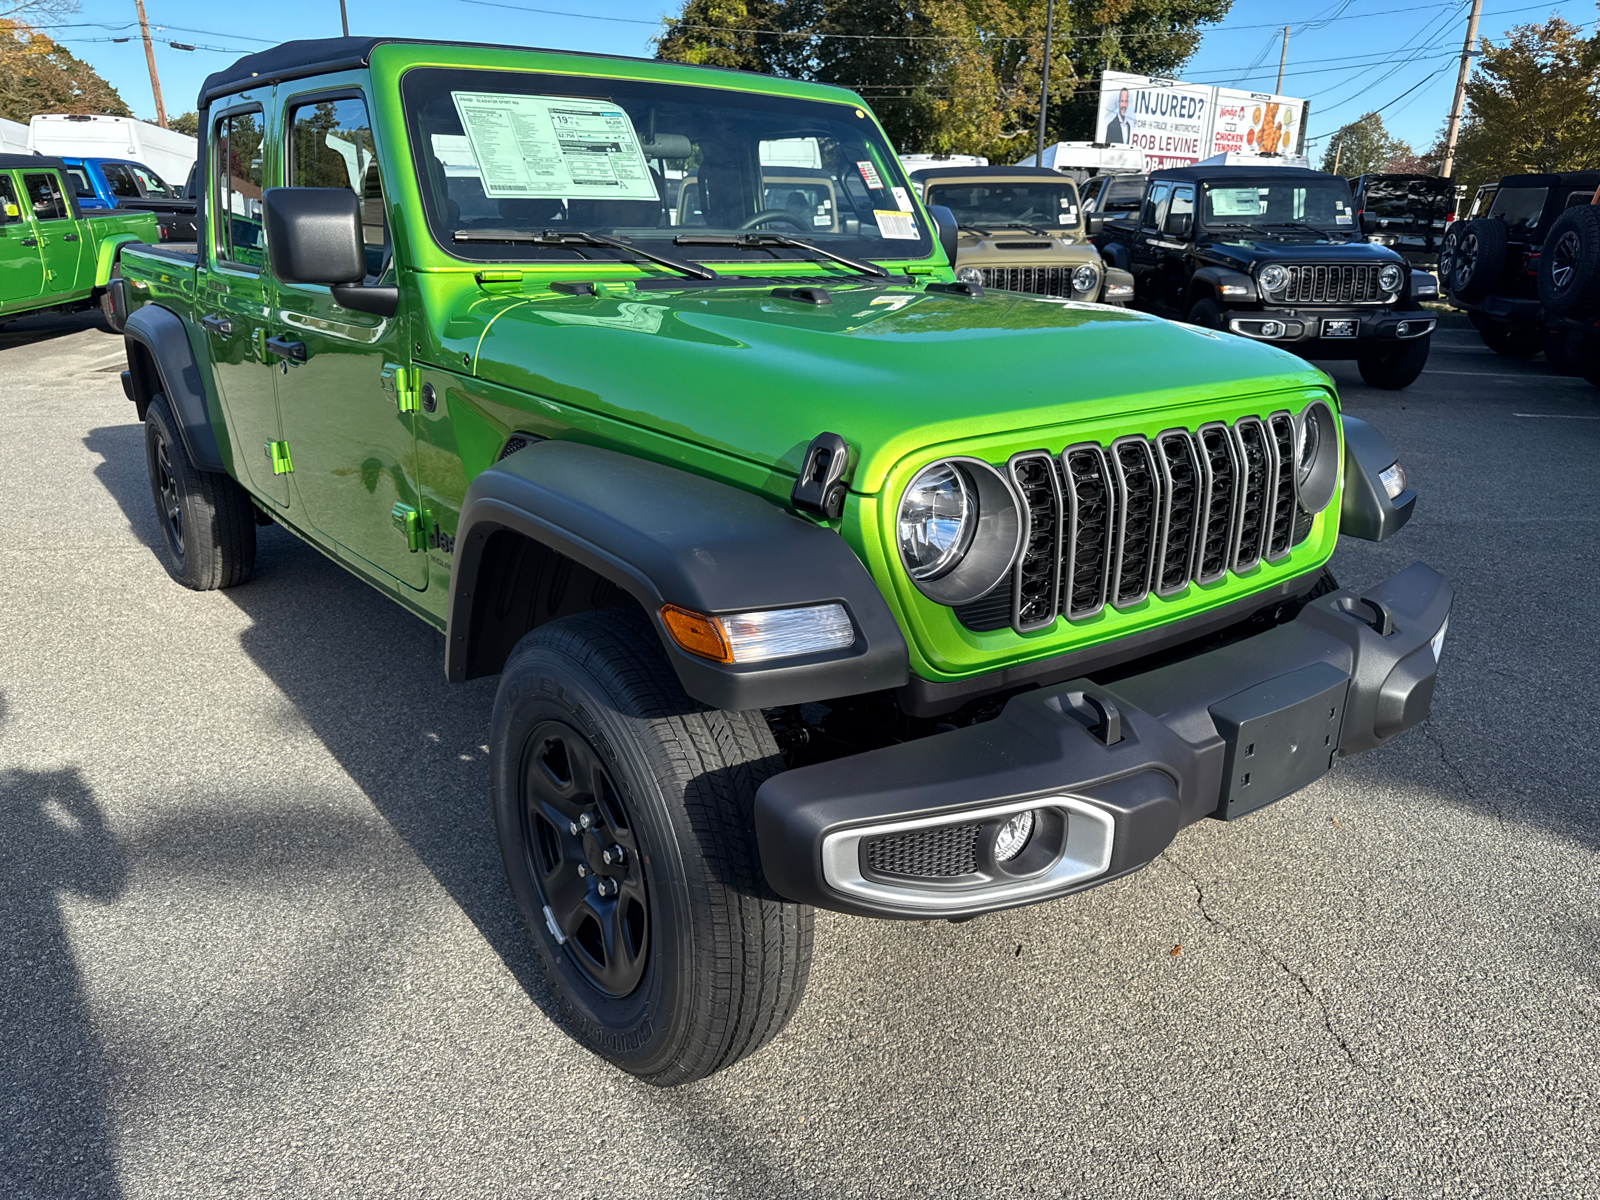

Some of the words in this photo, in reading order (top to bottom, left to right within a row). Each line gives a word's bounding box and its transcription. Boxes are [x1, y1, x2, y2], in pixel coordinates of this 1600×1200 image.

[1134, 90, 1205, 120] INJURED?
[556, 115, 569, 124] 19
[1131, 133, 1156, 150] ROB
[1158, 135, 1199, 154] LEVINE
[1215, 131, 1244, 143] CHICKEN
